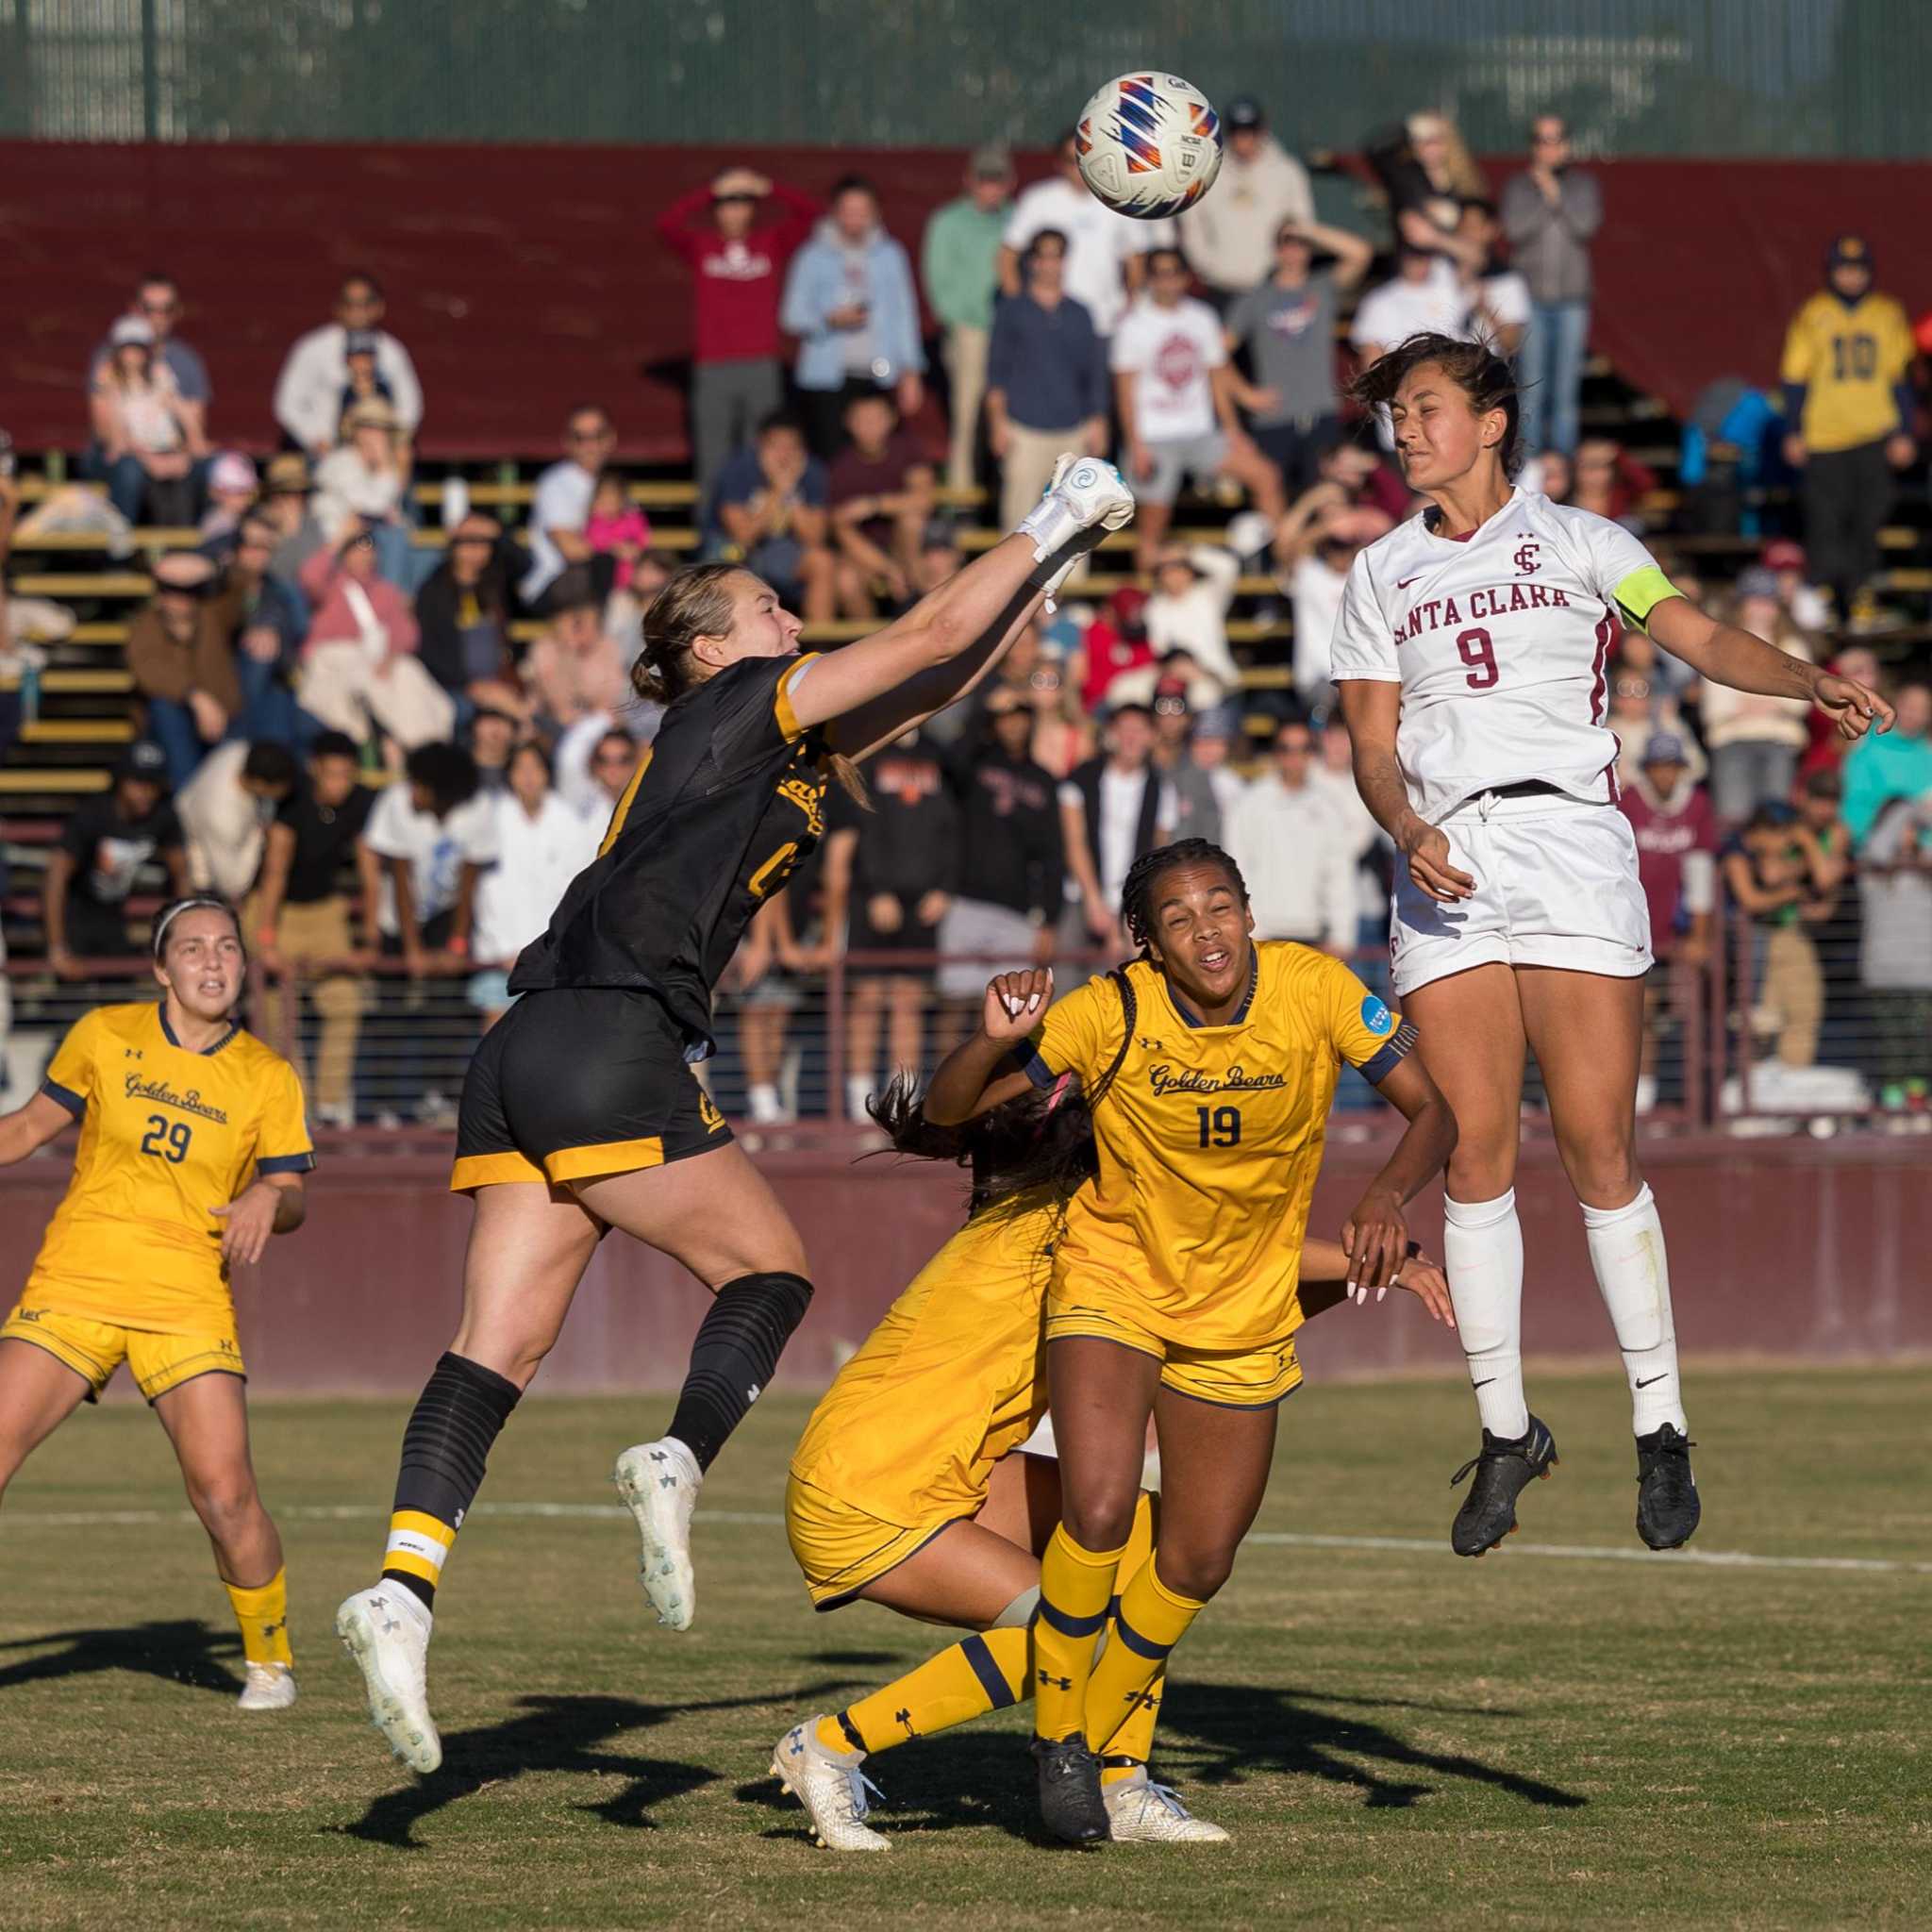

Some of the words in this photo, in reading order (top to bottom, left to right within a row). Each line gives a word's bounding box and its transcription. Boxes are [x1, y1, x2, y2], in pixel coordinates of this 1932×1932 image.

[1470, 584, 1571, 620] CLARA
[1456, 627, 1500, 690] 9
[125, 1072, 179, 1106] Golden
[180, 1089, 228, 1124] Bears
[1148, 1063, 1221, 1096] Golden
[1223, 1065, 1288, 1091] Bears
[141, 1114, 192, 1164] 29
[1196, 1106, 1241, 1149] 19
